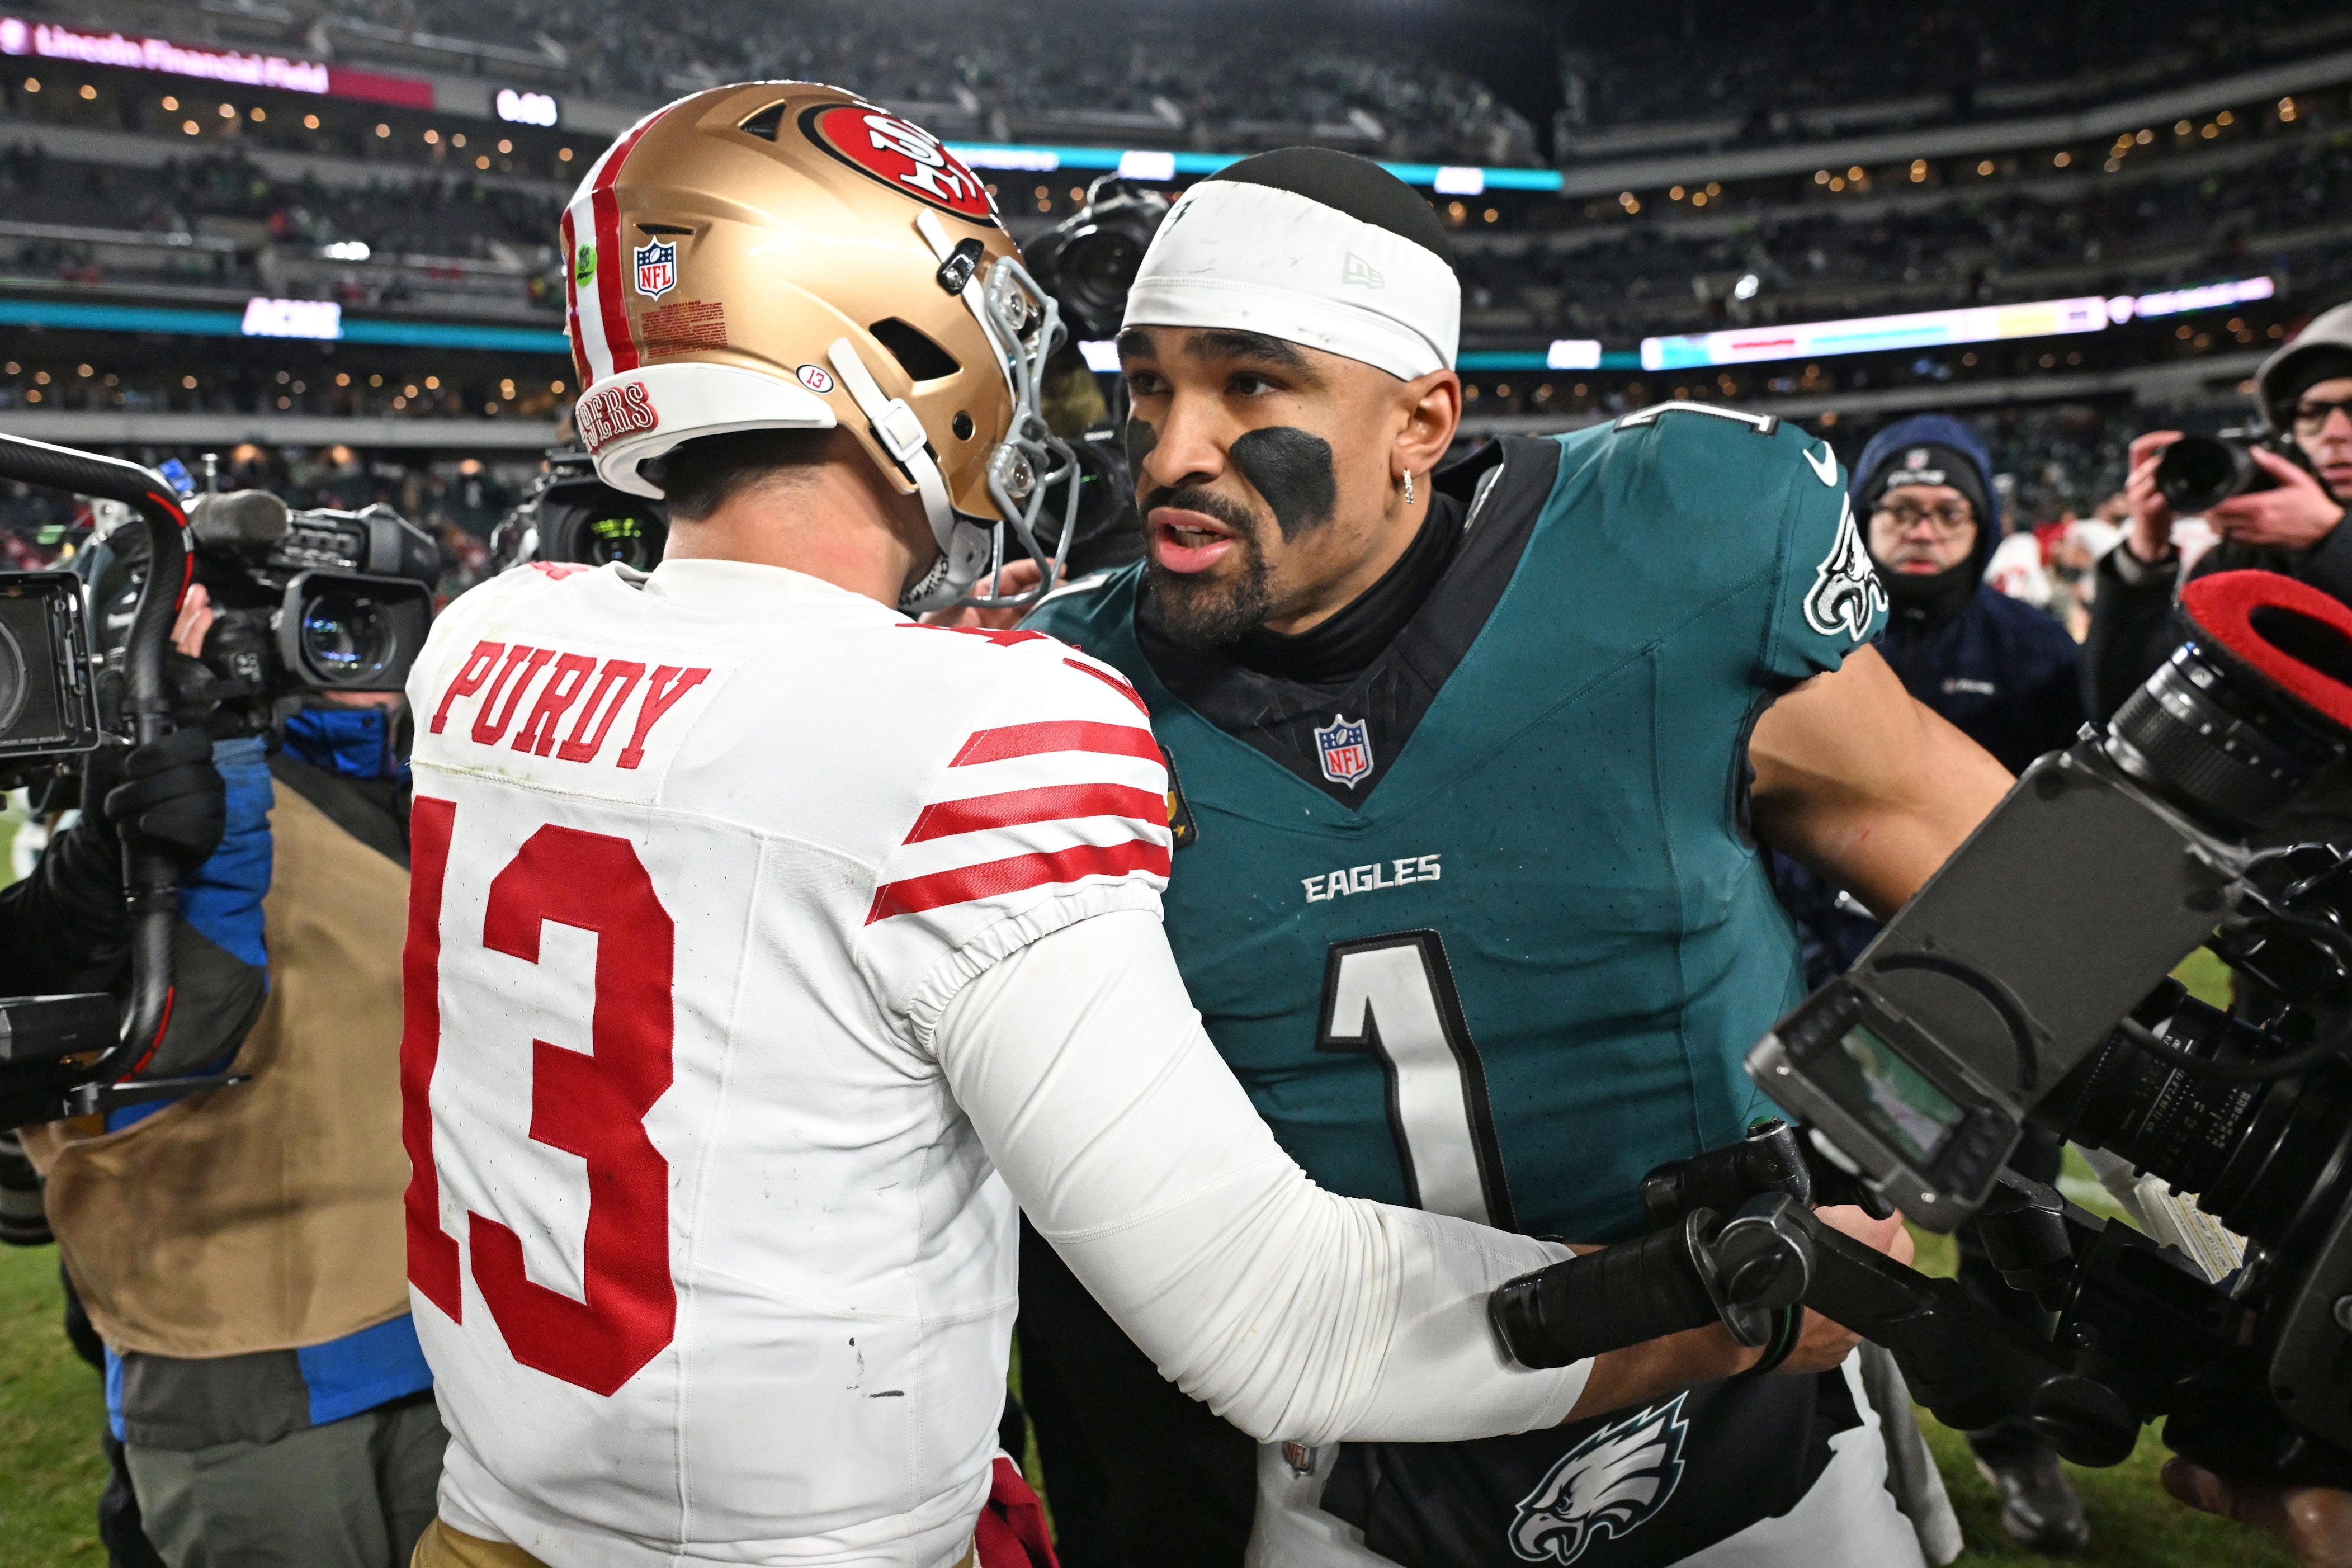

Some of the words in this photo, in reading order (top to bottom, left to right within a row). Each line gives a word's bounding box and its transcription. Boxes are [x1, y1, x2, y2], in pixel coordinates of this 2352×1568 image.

[641, 265, 671, 290] NFL
[659, 300, 701, 310] WARNING
[807, 370, 824, 388] 13
[430, 640, 712, 769] PURDY
[1327, 747, 1365, 776] NFL
[1301, 853, 1442, 903] EAGLES
[400, 794, 676, 1397] 13
[1316, 929, 1518, 1234] 1
